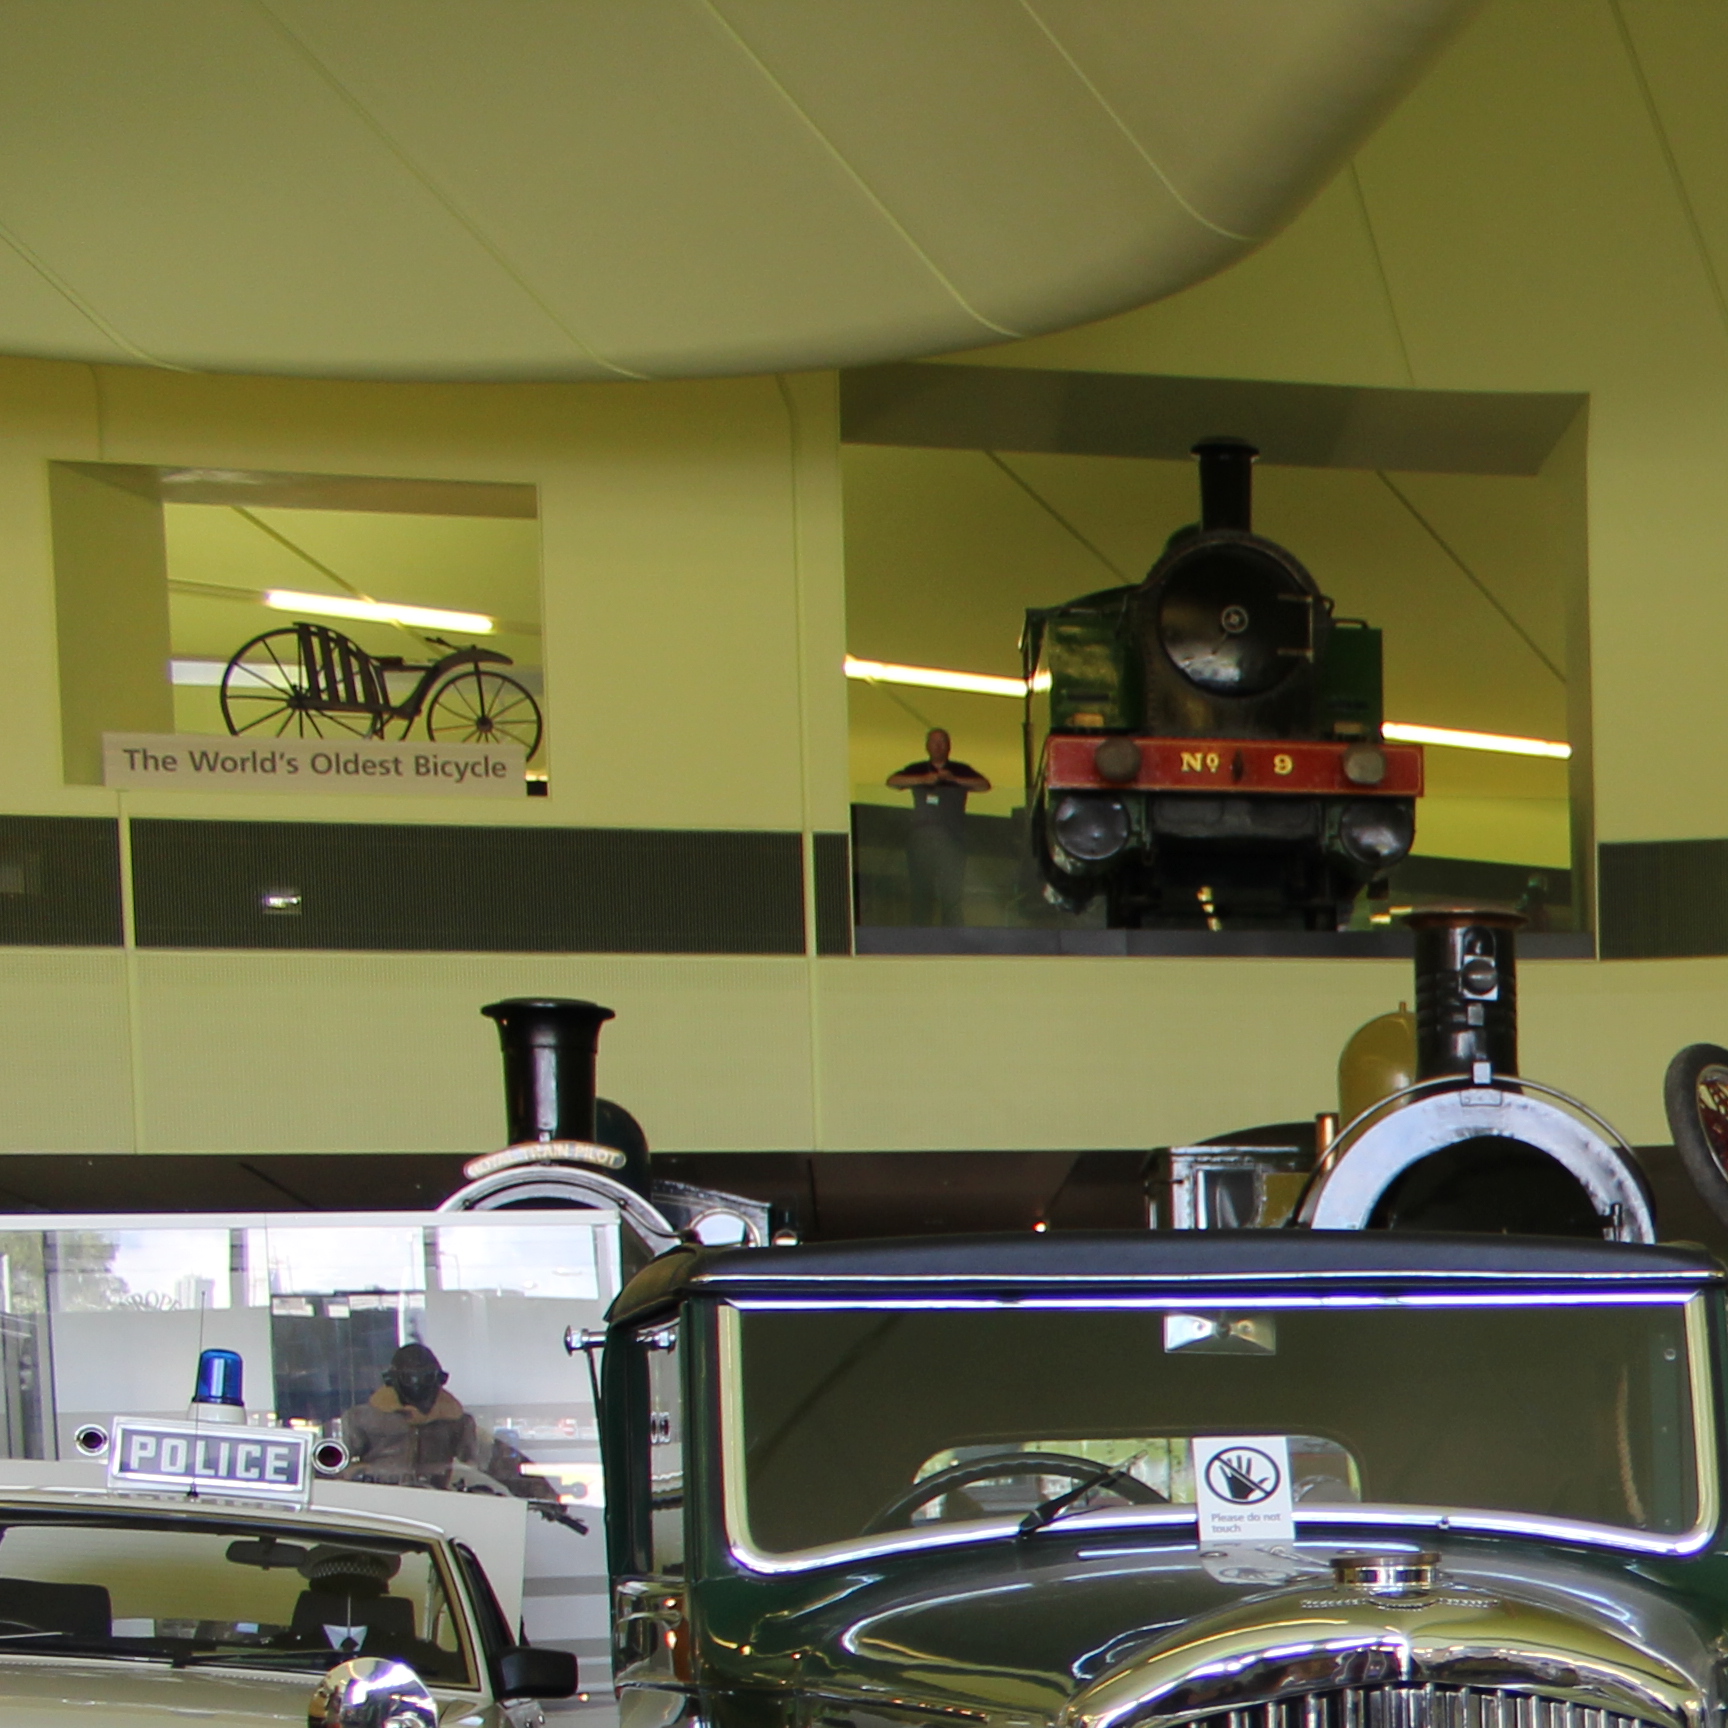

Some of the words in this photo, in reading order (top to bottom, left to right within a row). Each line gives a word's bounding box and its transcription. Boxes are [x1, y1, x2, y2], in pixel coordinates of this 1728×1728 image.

[124, 749, 177, 771] The
[189, 750, 299, 774] World's
[311, 752, 403, 776] Oldest
[414, 755, 506, 782] Bicycle
[1273, 754, 1293, 775] 9
[523, 1143, 569, 1160] TRAIN
[575, 1145, 620, 1166] PILOT
[130, 1435, 290, 1482] POLICE
[1211, 1513, 1244, 1521] Please
[1247, 1512, 1260, 1521] do
[1263, 1513, 1280, 1521] not
[1212, 1524, 1241, 1532] touch
